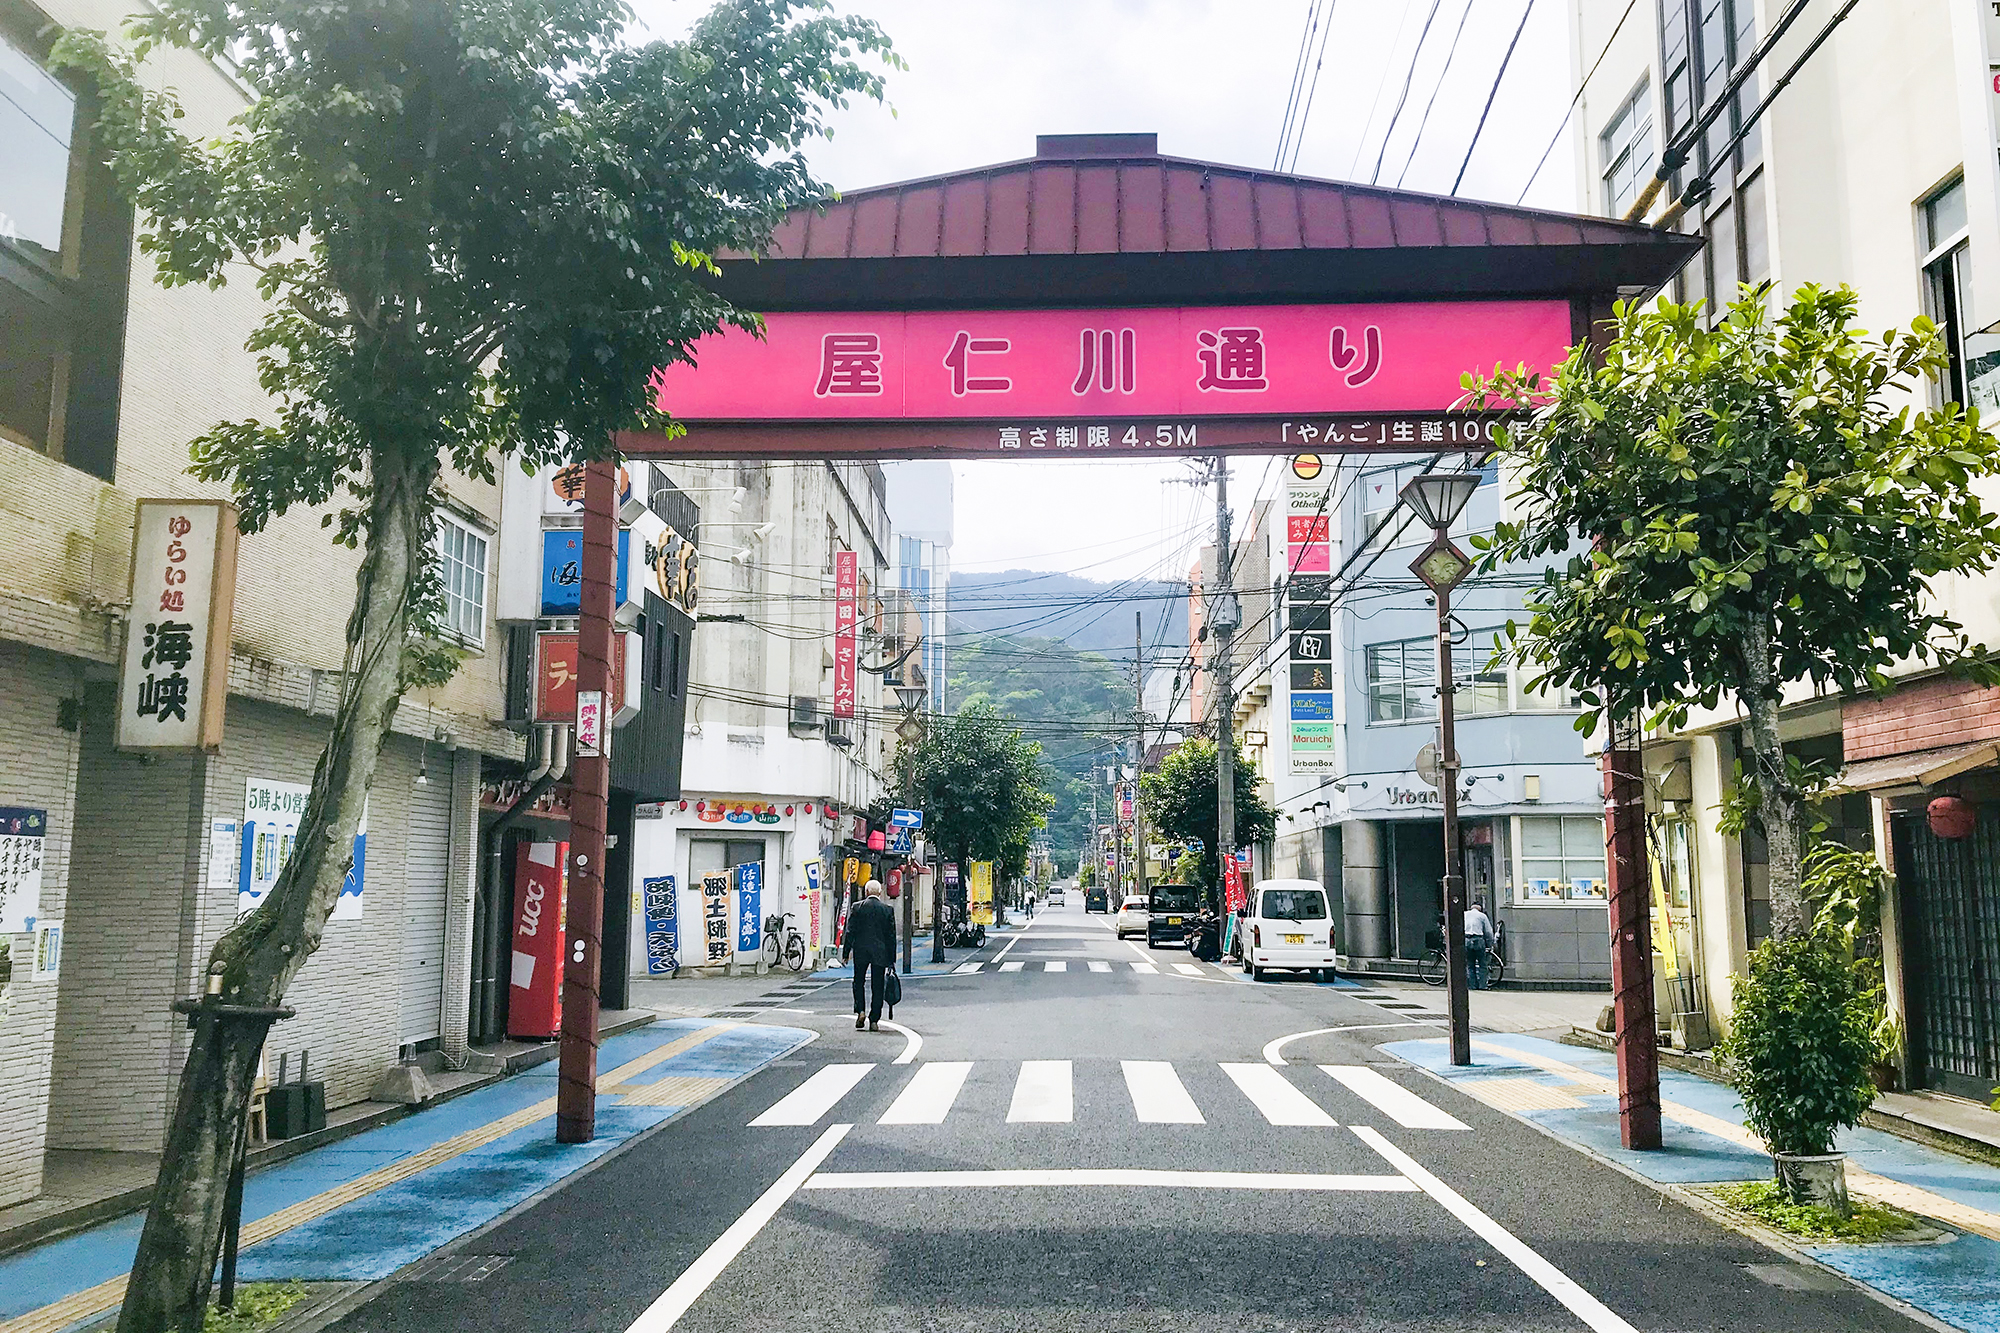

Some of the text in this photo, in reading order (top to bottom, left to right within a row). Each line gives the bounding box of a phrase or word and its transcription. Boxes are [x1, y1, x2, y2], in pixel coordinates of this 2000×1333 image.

[814, 323, 1382, 398] 屋仁川通り
[160, 516, 192, 612] ゆらい処
[840, 556, 851, 584] 居酒屋
[137, 620, 193, 723] 海峡
[836, 647, 853, 713] さしみや
[1293, 734, 1332, 743] Maruichi
[1386, 787, 1472, 804] Urbanx
